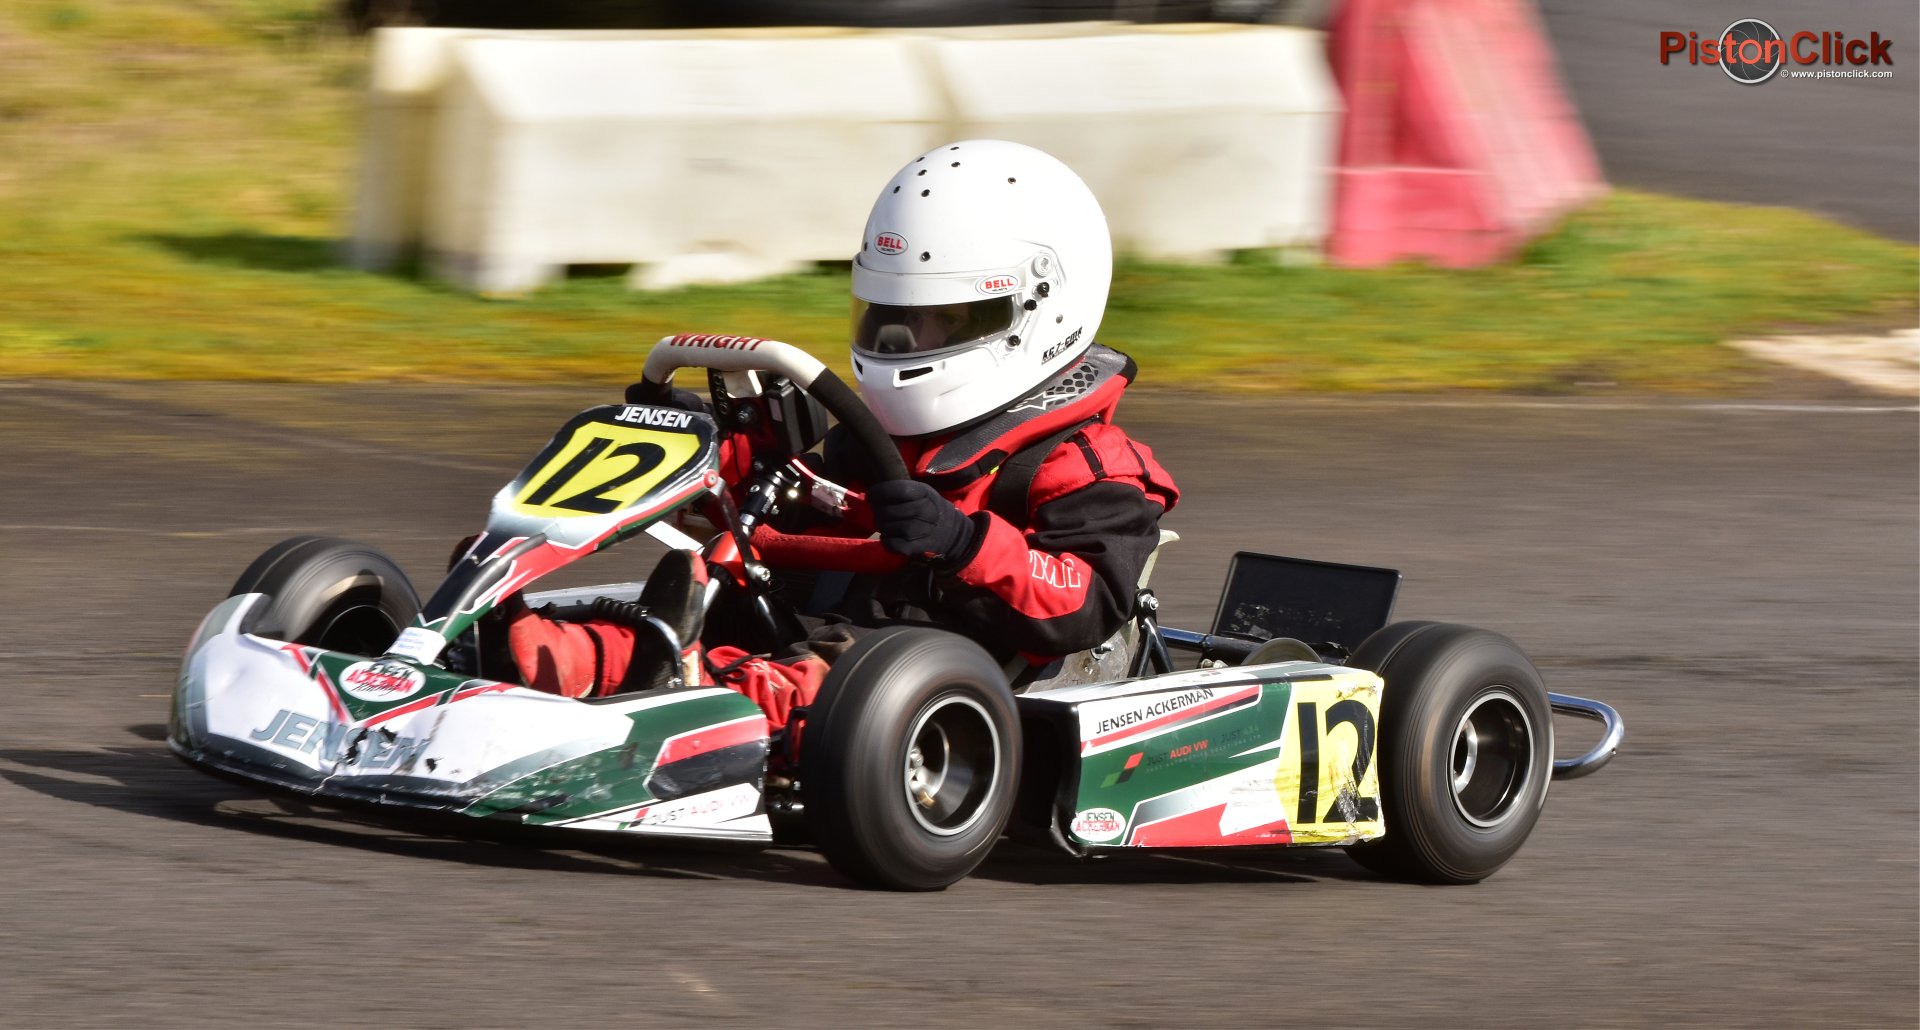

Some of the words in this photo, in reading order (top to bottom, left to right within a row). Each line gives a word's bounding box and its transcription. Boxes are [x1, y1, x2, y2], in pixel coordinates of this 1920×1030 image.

[877, 236, 903, 249] BELL
[984, 278, 1015, 290] BELL
[669, 332, 772, 351] WRIGHT
[614, 406, 693, 429] JENSEN
[522, 436, 666, 515] 12
[1096, 708, 1143, 735] JENSEN
[1145, 687, 1214, 720] ACKERMAN
[1169, 744, 1193, 759] AUDI
[1193, 739, 1209, 752] VW
[1296, 699, 1379, 825] 12
[650, 807, 686, 826] JUST
